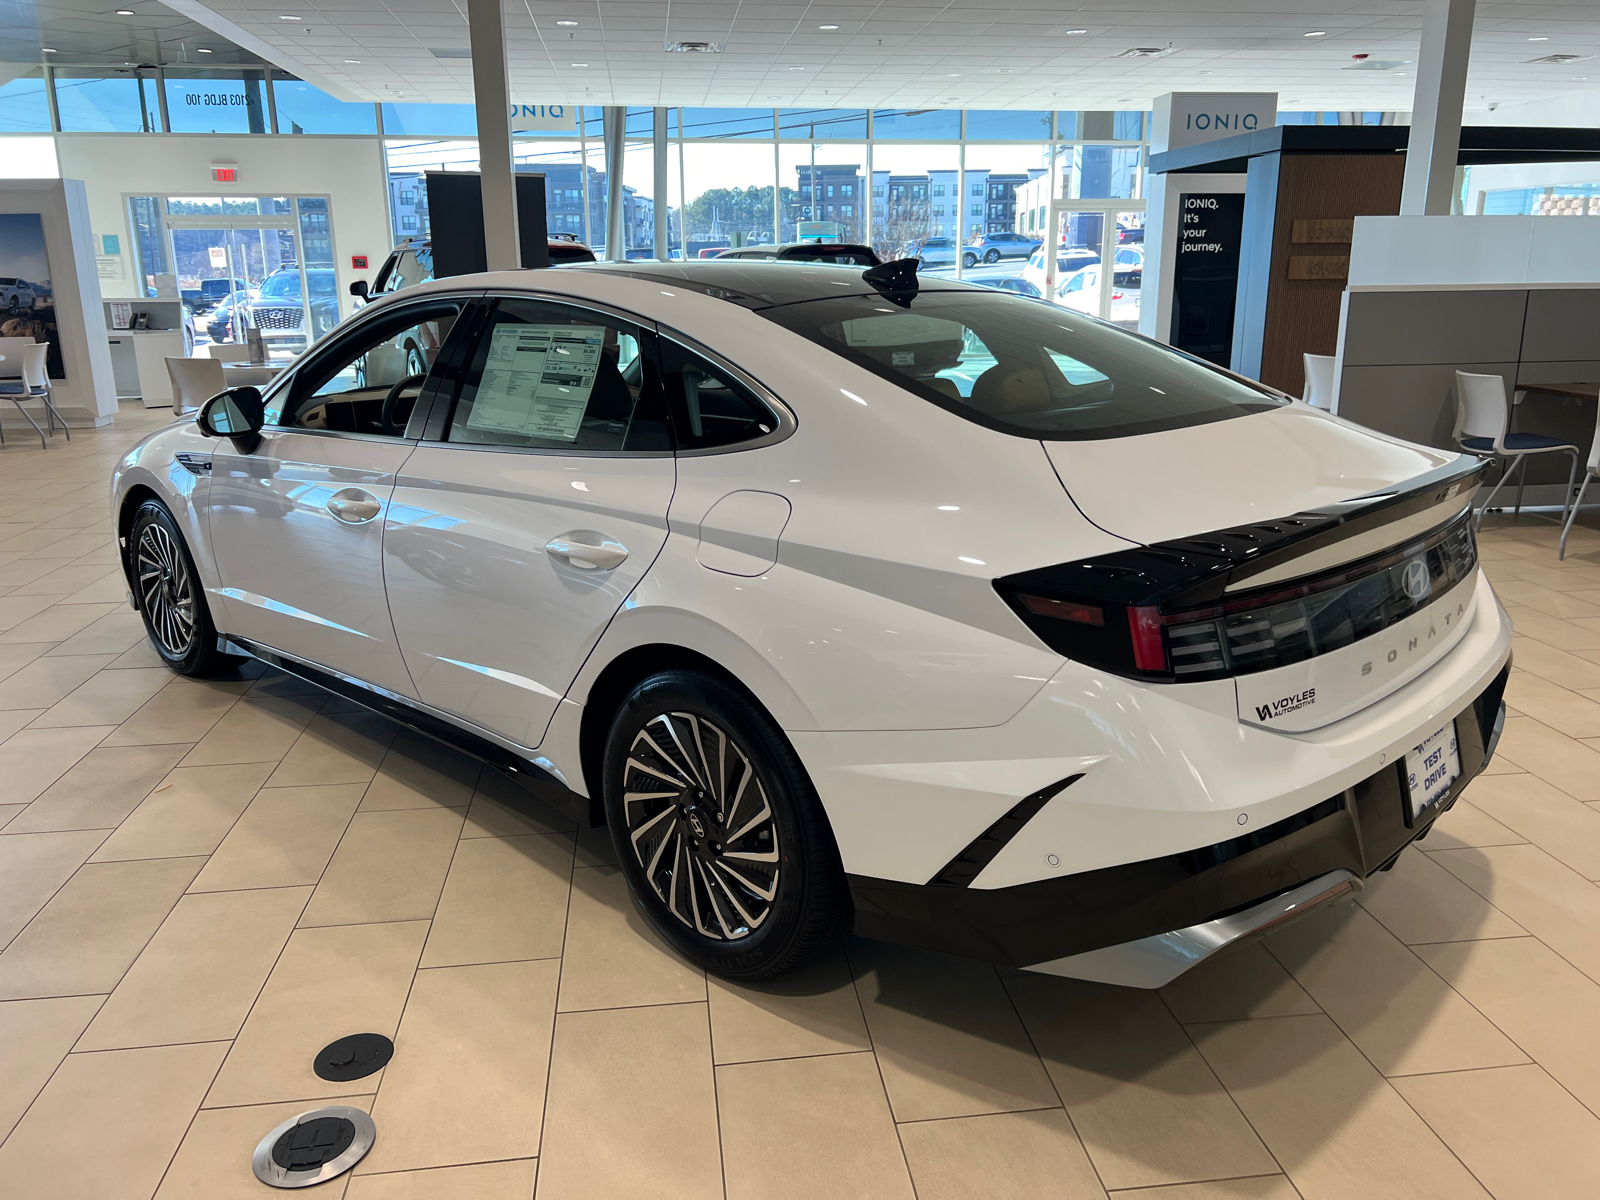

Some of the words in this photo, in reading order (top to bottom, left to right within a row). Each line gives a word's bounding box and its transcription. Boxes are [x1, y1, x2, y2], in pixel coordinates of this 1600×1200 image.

[1186, 113, 1258, 131] IONIQ
[216, 168, 234, 182] EXIT
[1185, 198, 1219, 210] IONIQ.
[1184, 213, 1199, 223] It's
[1183, 229, 1207, 240] your
[1181, 241, 1223, 254] journey.
[1361, 603, 1464, 677] SONATA
[1272, 688, 1315, 710] VOYLES
[1273, 698, 1316, 717] AUTOMOTIVE
[1423, 746, 1442, 771] TEST
[1424, 762, 1447, 791] DRIVE
